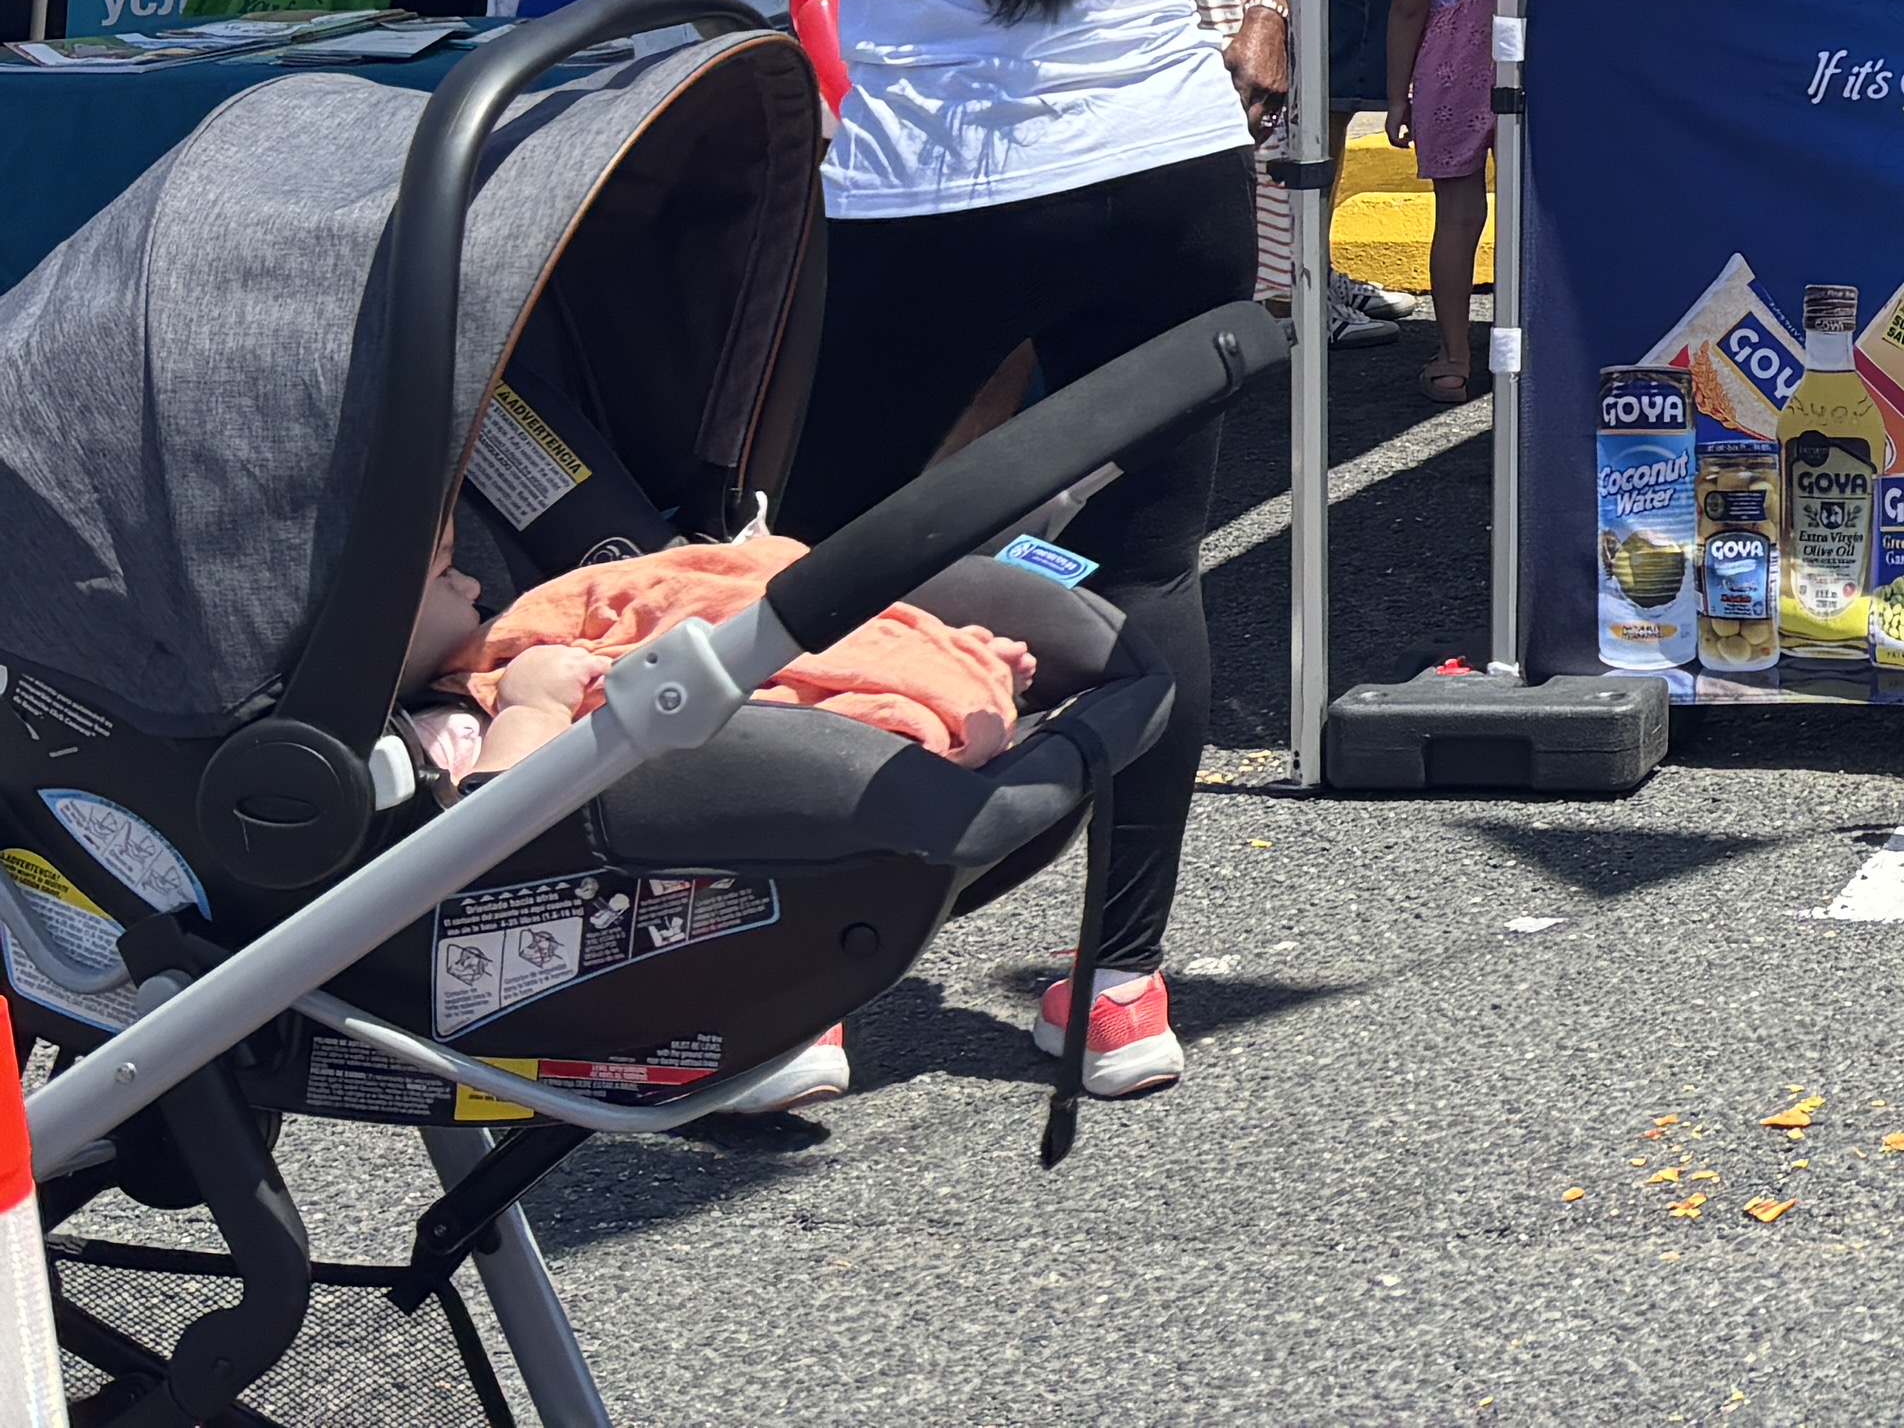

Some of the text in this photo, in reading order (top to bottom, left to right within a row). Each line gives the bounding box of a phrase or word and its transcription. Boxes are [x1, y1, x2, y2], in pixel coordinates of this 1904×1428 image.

[1807, 49, 1844, 105] If
[1842, 58, 1892, 101] it's
[1728, 327, 1801, 401] GOY
[1602, 394, 1685, 427] GOYA
[505, 397, 583, 475] ADVERTENCIA
[1600, 449, 1692, 499] Coconut
[1798, 472, 1868, 497] GOYA
[1616, 485, 1676, 518] Water
[1711, 540, 1764, 560] GOYA
[1834, 544, 1856, 558] Oil
